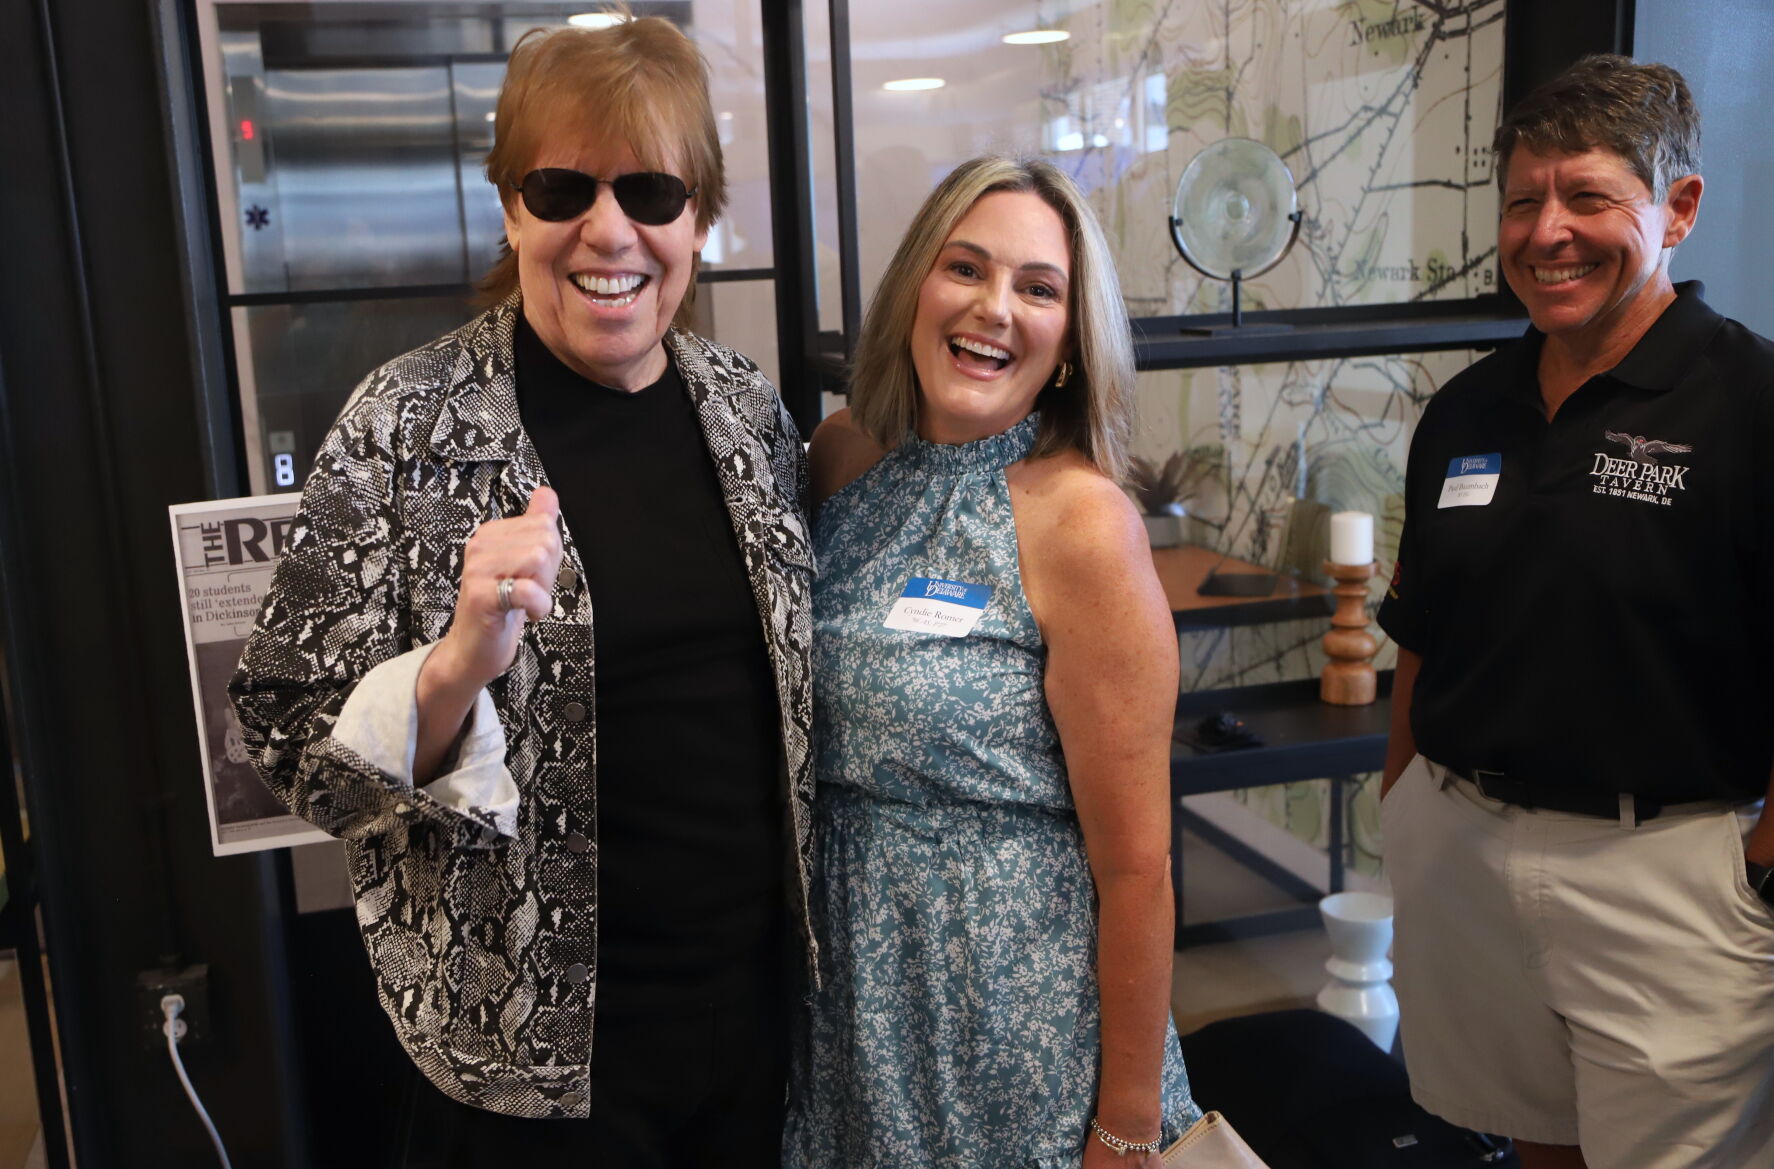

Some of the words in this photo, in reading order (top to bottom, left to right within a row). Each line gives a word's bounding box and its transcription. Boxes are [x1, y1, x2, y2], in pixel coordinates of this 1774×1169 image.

[1350, 5, 1425, 46] Newark
[1353, 258, 1420, 281] Newark
[1589, 453, 1638, 479] DEER
[1639, 463, 1690, 490] PARK
[1600, 475, 1669, 495] TAVERN
[1609, 487, 1626, 498] 1851
[1661, 497, 1673, 506] DE
[200, 520, 225, 568] THE
[188, 587, 200, 599] 20
[203, 584, 251, 597] students
[190, 598, 212, 611] still
[193, 614, 203, 624] in
